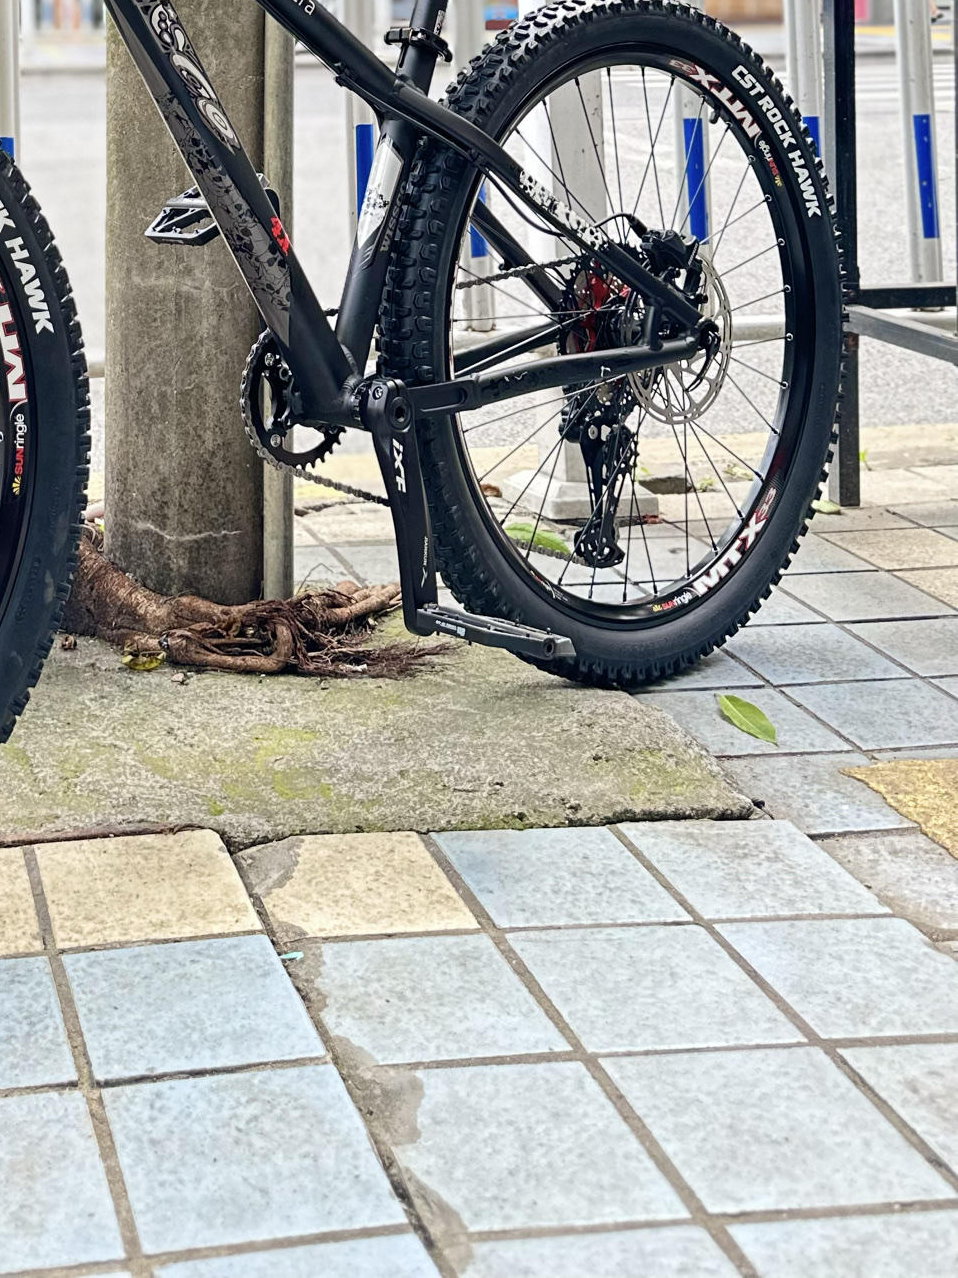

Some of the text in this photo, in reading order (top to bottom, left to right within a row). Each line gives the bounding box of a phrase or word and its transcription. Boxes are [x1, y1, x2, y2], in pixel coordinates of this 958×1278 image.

[732, 65, 822, 218] CST ROCK HAWK
[5, 238, 55, 334] HAWK
